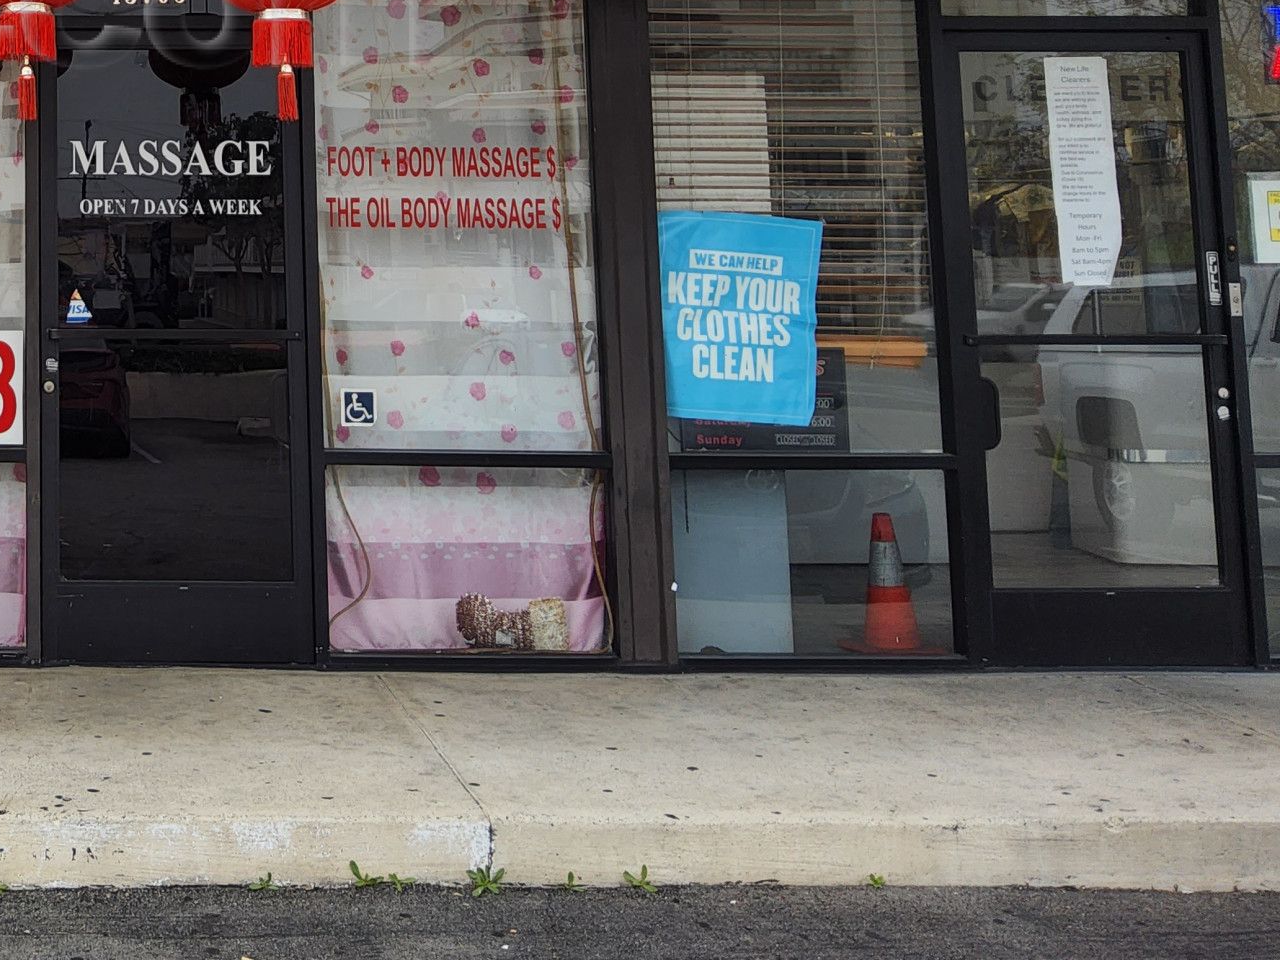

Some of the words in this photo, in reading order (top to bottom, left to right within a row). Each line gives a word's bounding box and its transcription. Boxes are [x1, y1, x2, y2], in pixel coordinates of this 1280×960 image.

[70, 140, 271, 176] MASSAGE
[327, 146, 375, 177] FOOT
[381, 151, 390, 172] +
[396, 146, 446, 177] BODY
[452, 146, 541, 178] MASSAGE
[546, 145, 556, 180] $
[79, 198, 126, 215] OPEN
[131, 199, 139, 215] 7
[144, 198, 188, 215] DAYS
[192, 199, 205, 215] A
[209, 199, 263, 215] WEEK
[326, 197, 361, 228] THE
[367, 197, 396, 228] OIL
[400, 197, 451, 229] BODY
[456, 197, 547, 229] MASSAGE
[552, 196, 561, 232] $
[694, 253, 716, 266] WE
[719, 254, 744, 268] CAN
[747, 256, 778, 271] HELP
[1209, 256, 1219, 292] PULL
[668, 271, 731, 307] KEEP
[736, 275, 800, 315] YOUR
[677, 307, 791, 347] CLOTHES
[692, 343, 774, 383] CLEAN
[696, 434, 743, 447] Sunday
